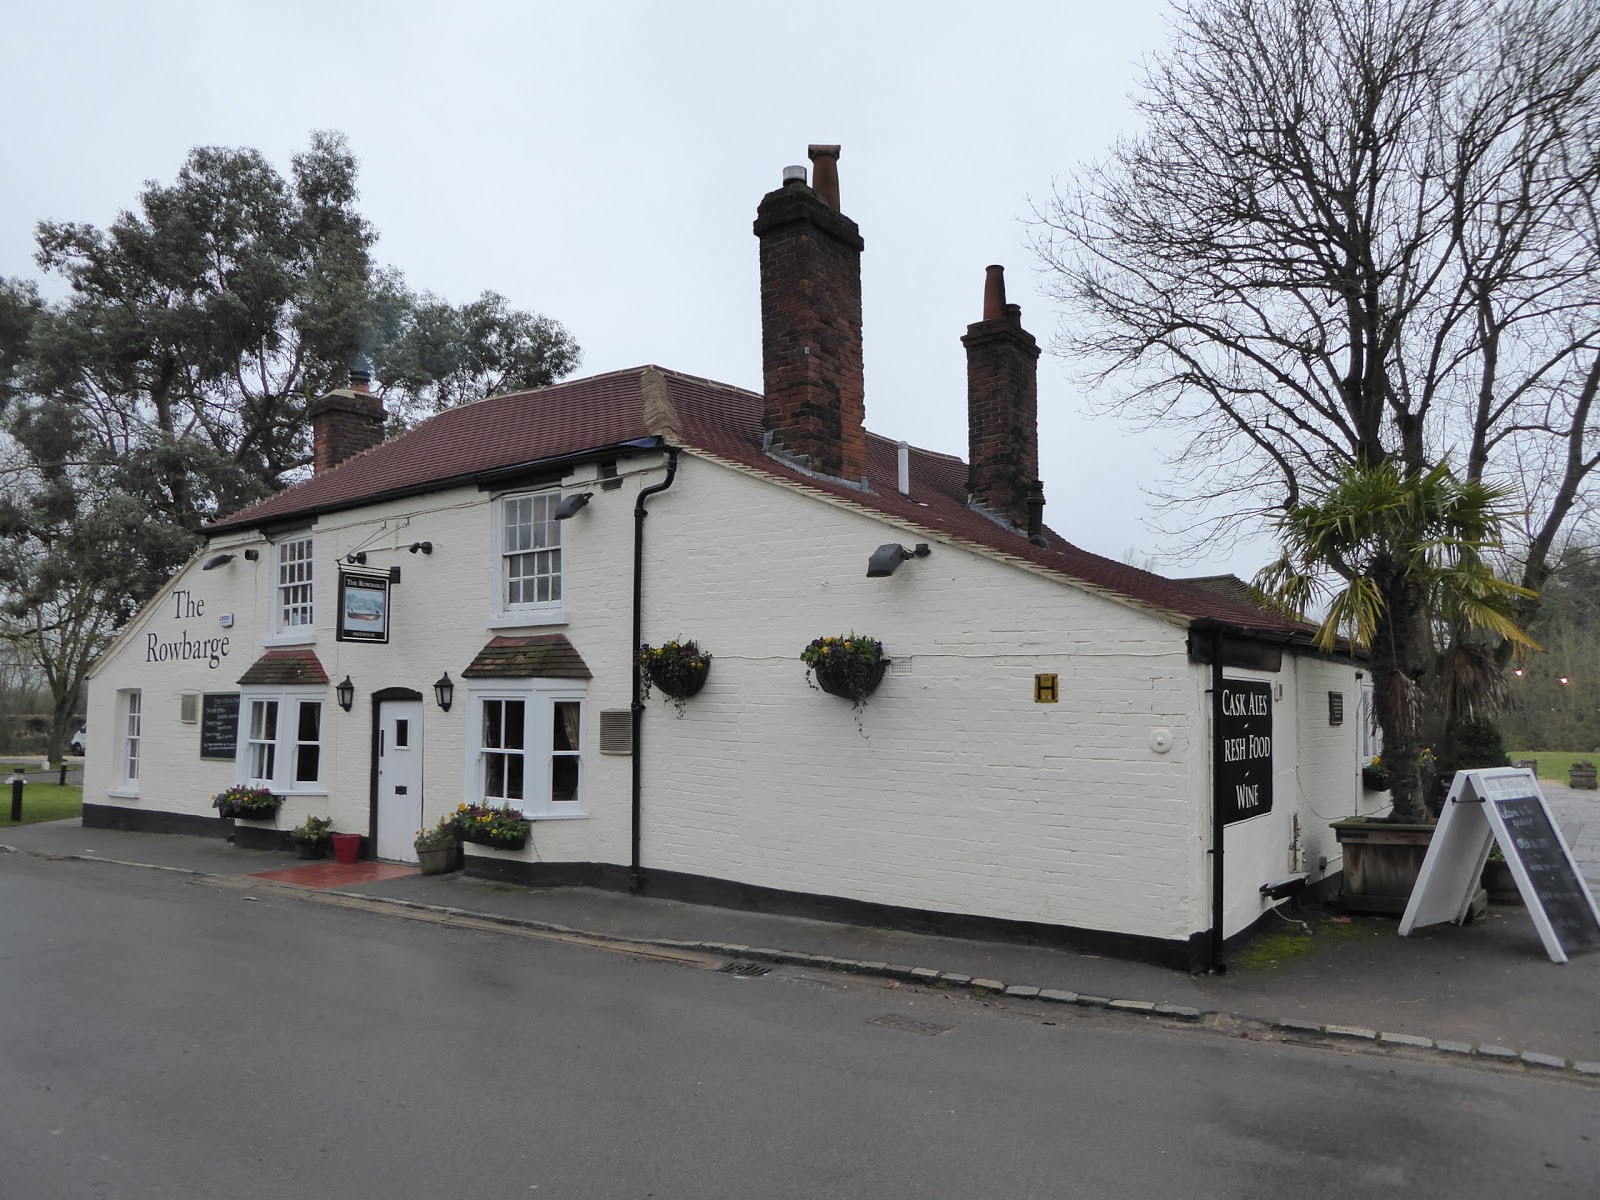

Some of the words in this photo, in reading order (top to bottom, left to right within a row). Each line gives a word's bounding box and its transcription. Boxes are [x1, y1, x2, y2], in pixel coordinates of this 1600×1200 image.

[171, 590, 205, 619] The
[146, 630, 230, 669] Rowbarge
[1037, 676, 1055, 701] H
[1222, 689, 1247, 716] CASK
[1248, 691, 1267, 716] ALES
[1223, 737, 1246, 762] RESH
[1249, 734, 1271, 760] FOOD
[1235, 783, 1259, 810] WINE
